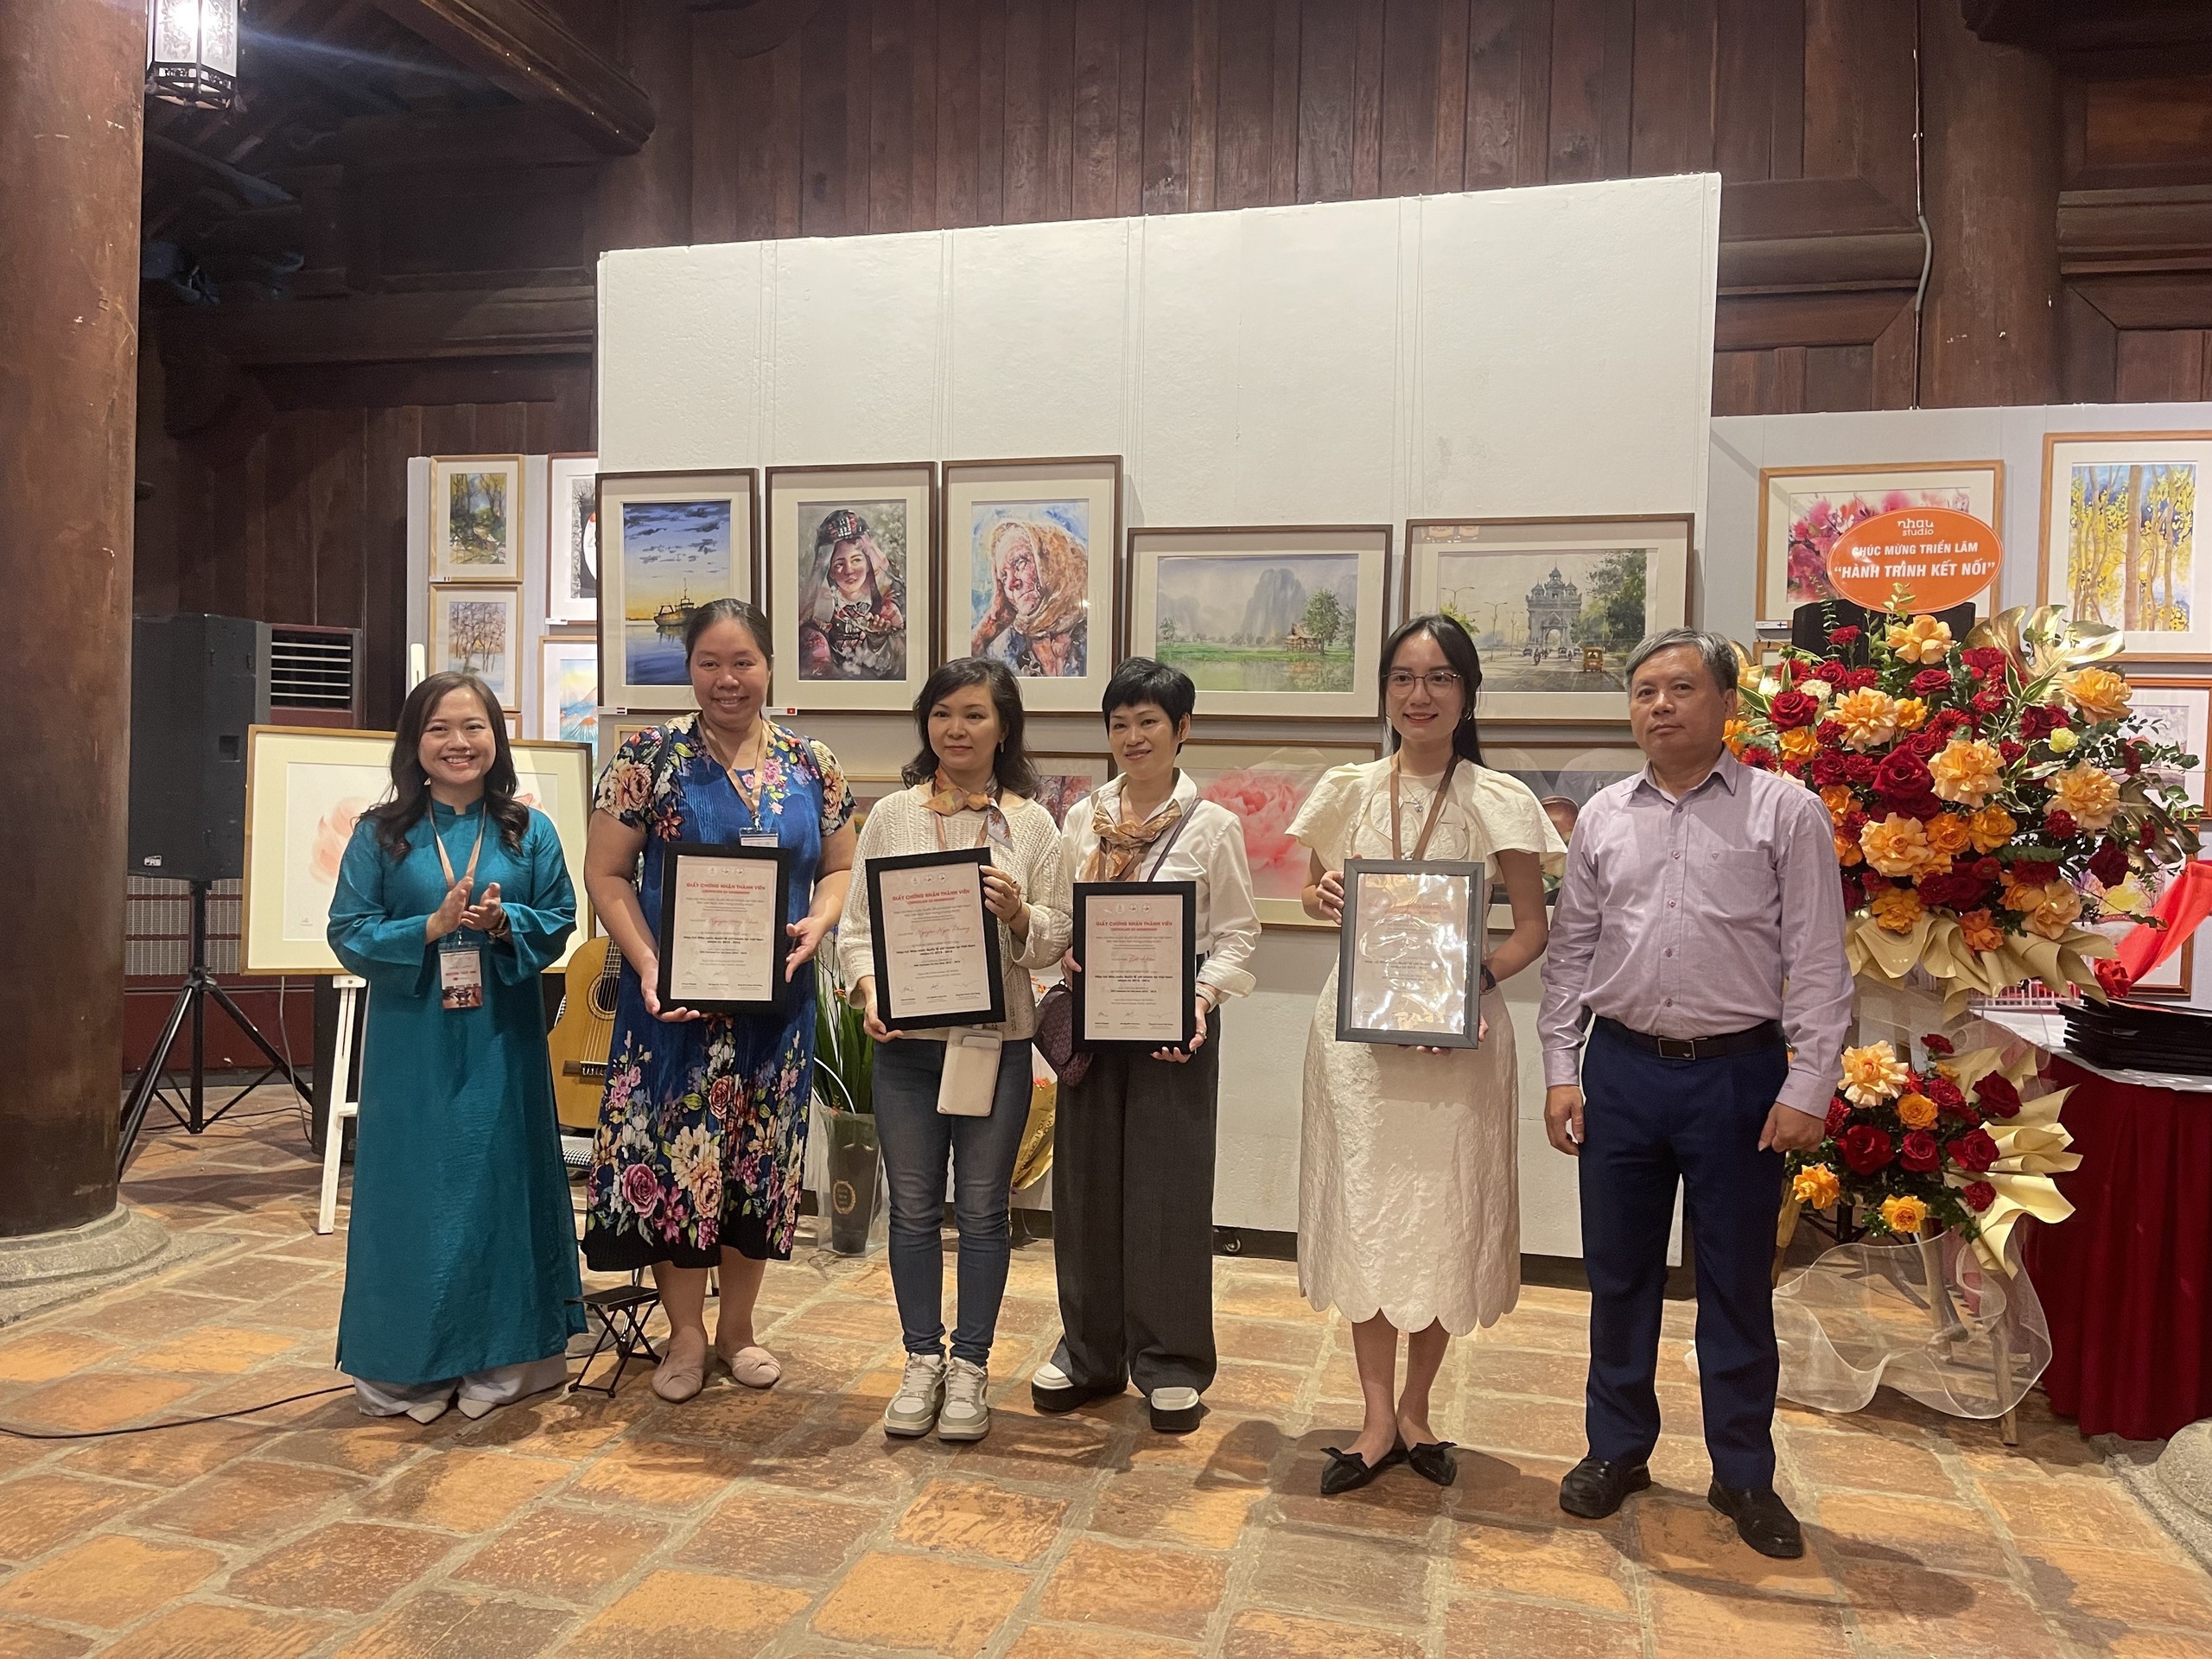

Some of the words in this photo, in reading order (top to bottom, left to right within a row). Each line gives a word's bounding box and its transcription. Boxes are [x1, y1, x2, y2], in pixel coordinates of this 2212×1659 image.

[1897, 518, 1934, 528] nhau
[1903, 528, 1934, 537] studio
[1852, 544, 1881, 557] CHÚC
[1885, 543, 1916, 556] MỪNG
[1920, 539, 1951, 554] TRIỂN
[1931, 559, 1957, 577] KẾT
